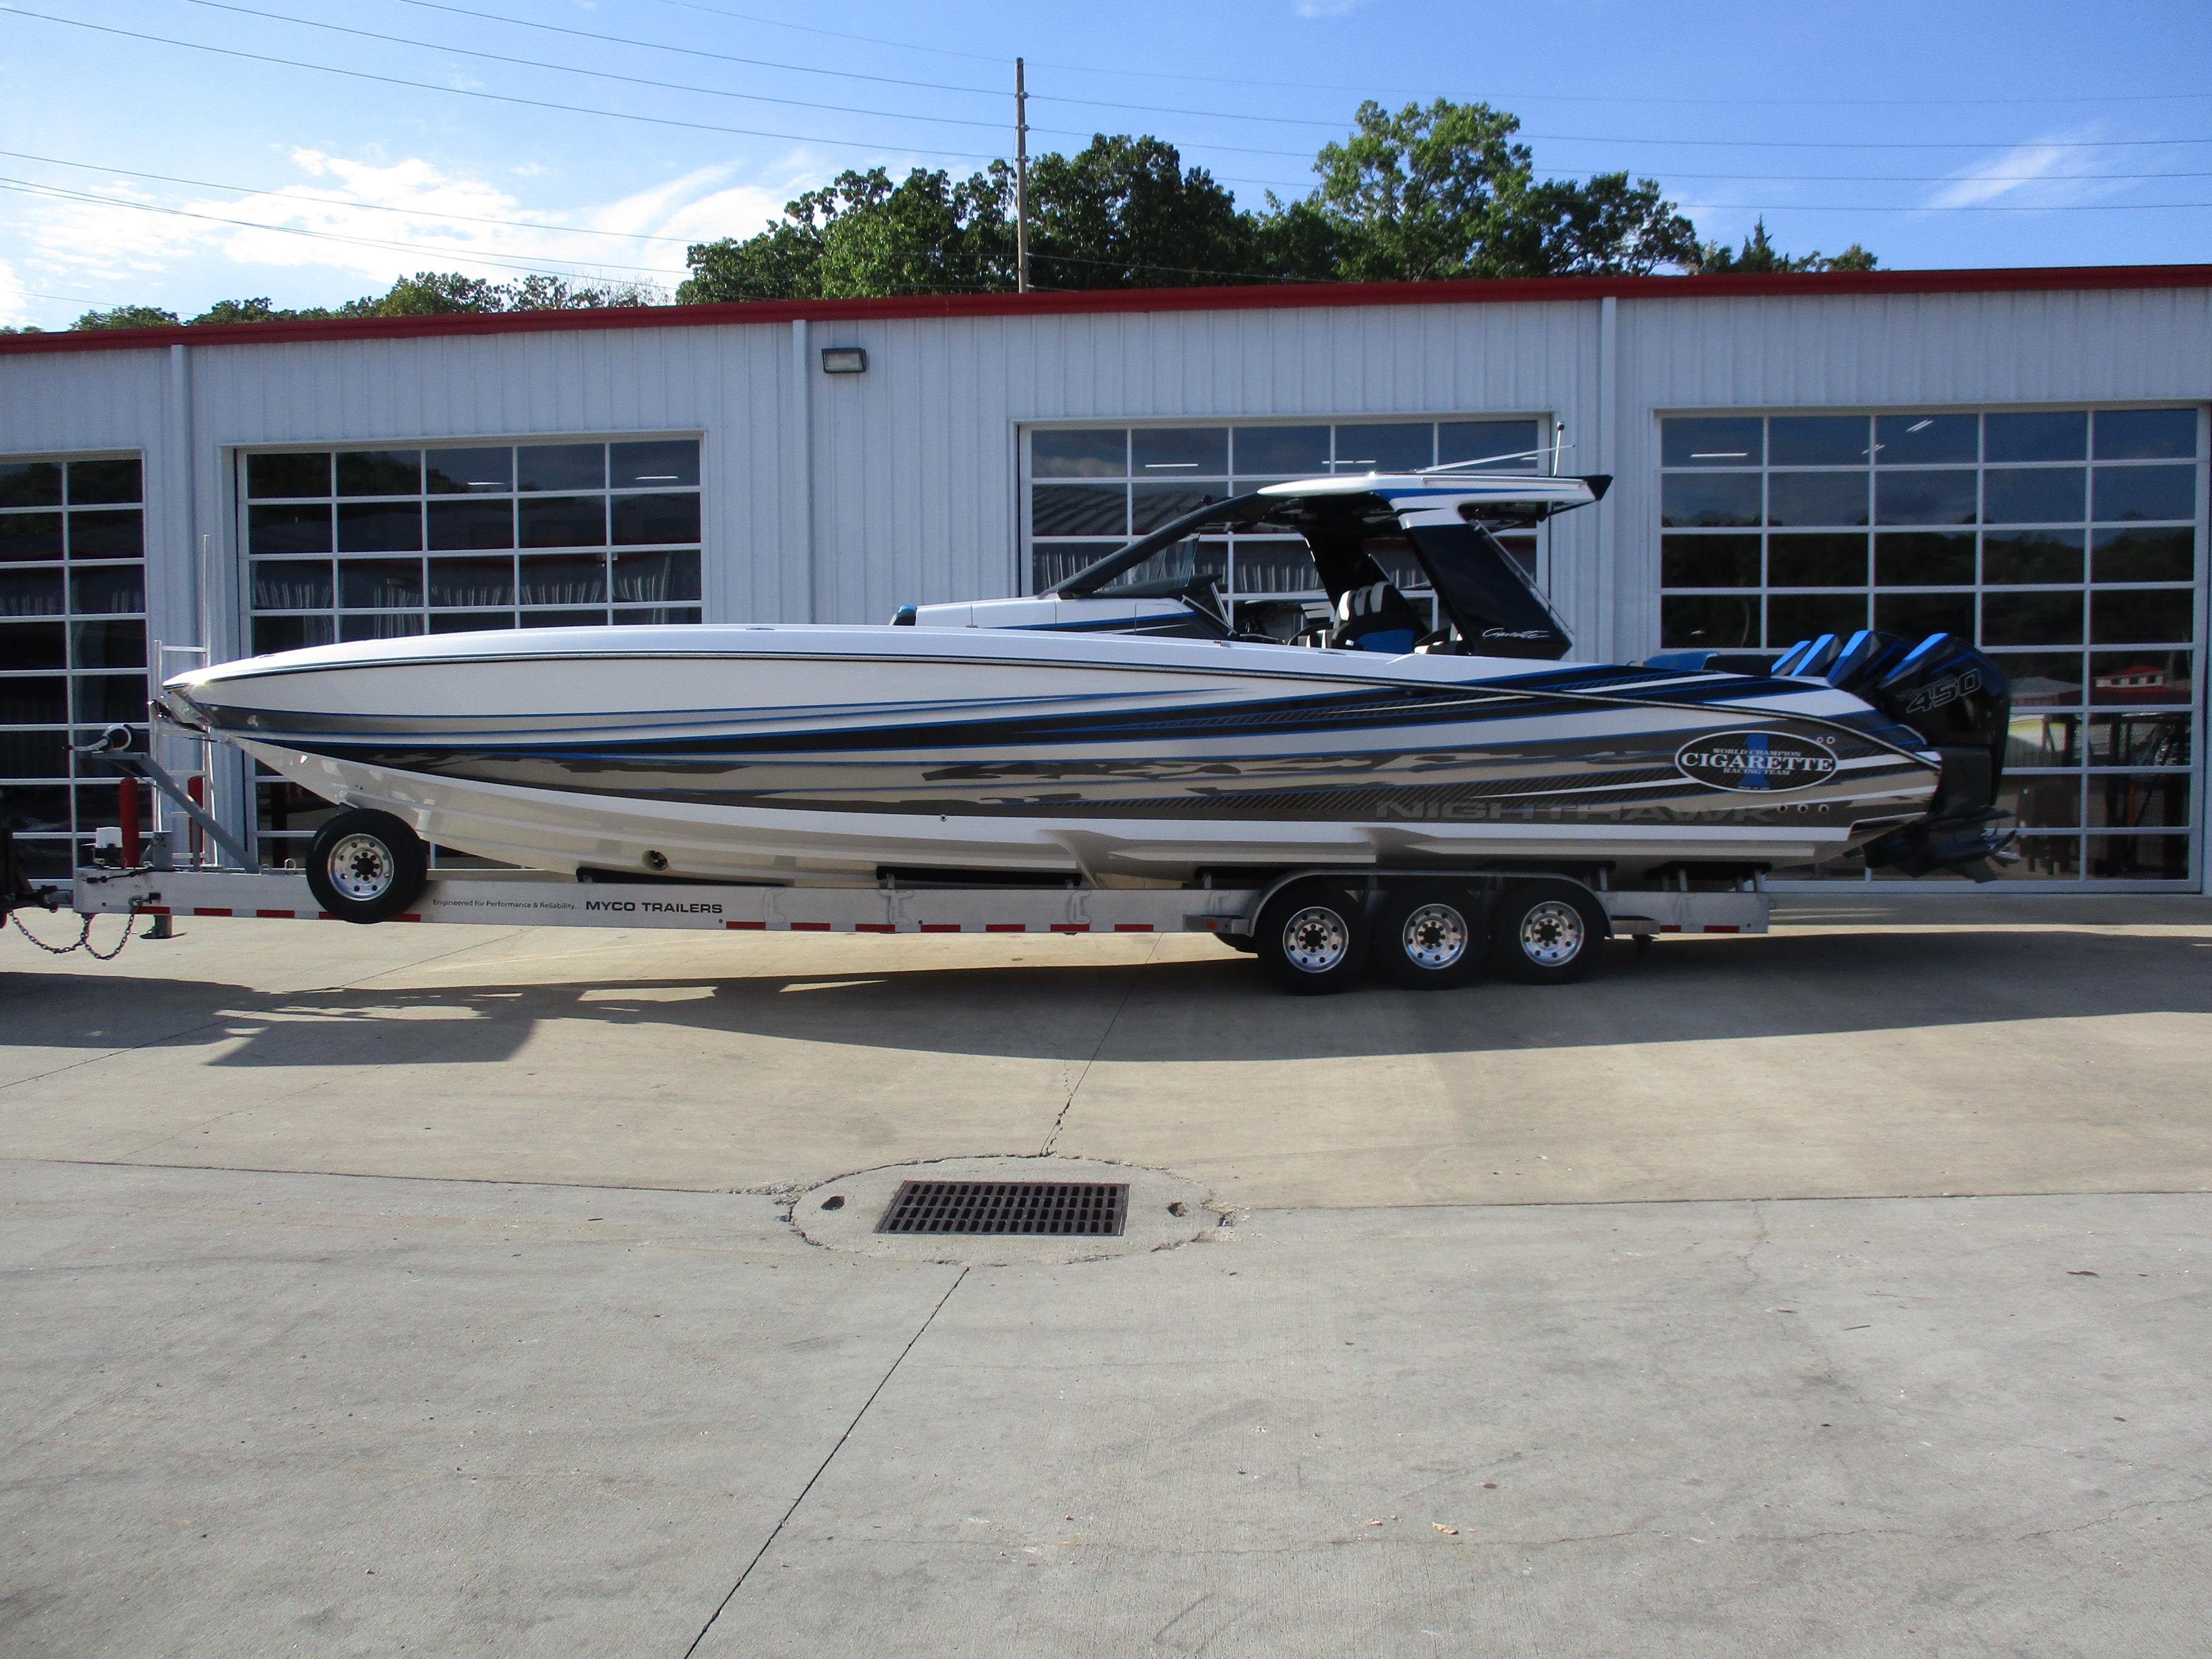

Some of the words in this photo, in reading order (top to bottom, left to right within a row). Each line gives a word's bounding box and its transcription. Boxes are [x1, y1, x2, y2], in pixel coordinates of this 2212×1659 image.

[1906, 668, 1980, 713] 450
[1681, 752, 1834, 772] CIGARETTE
[1375, 800, 1777, 823] NIGHTHAWK
[433, 899, 473, 907] Engineered
[586, 901, 635, 911] MYCO
[642, 902, 723, 913] TRAILERS
